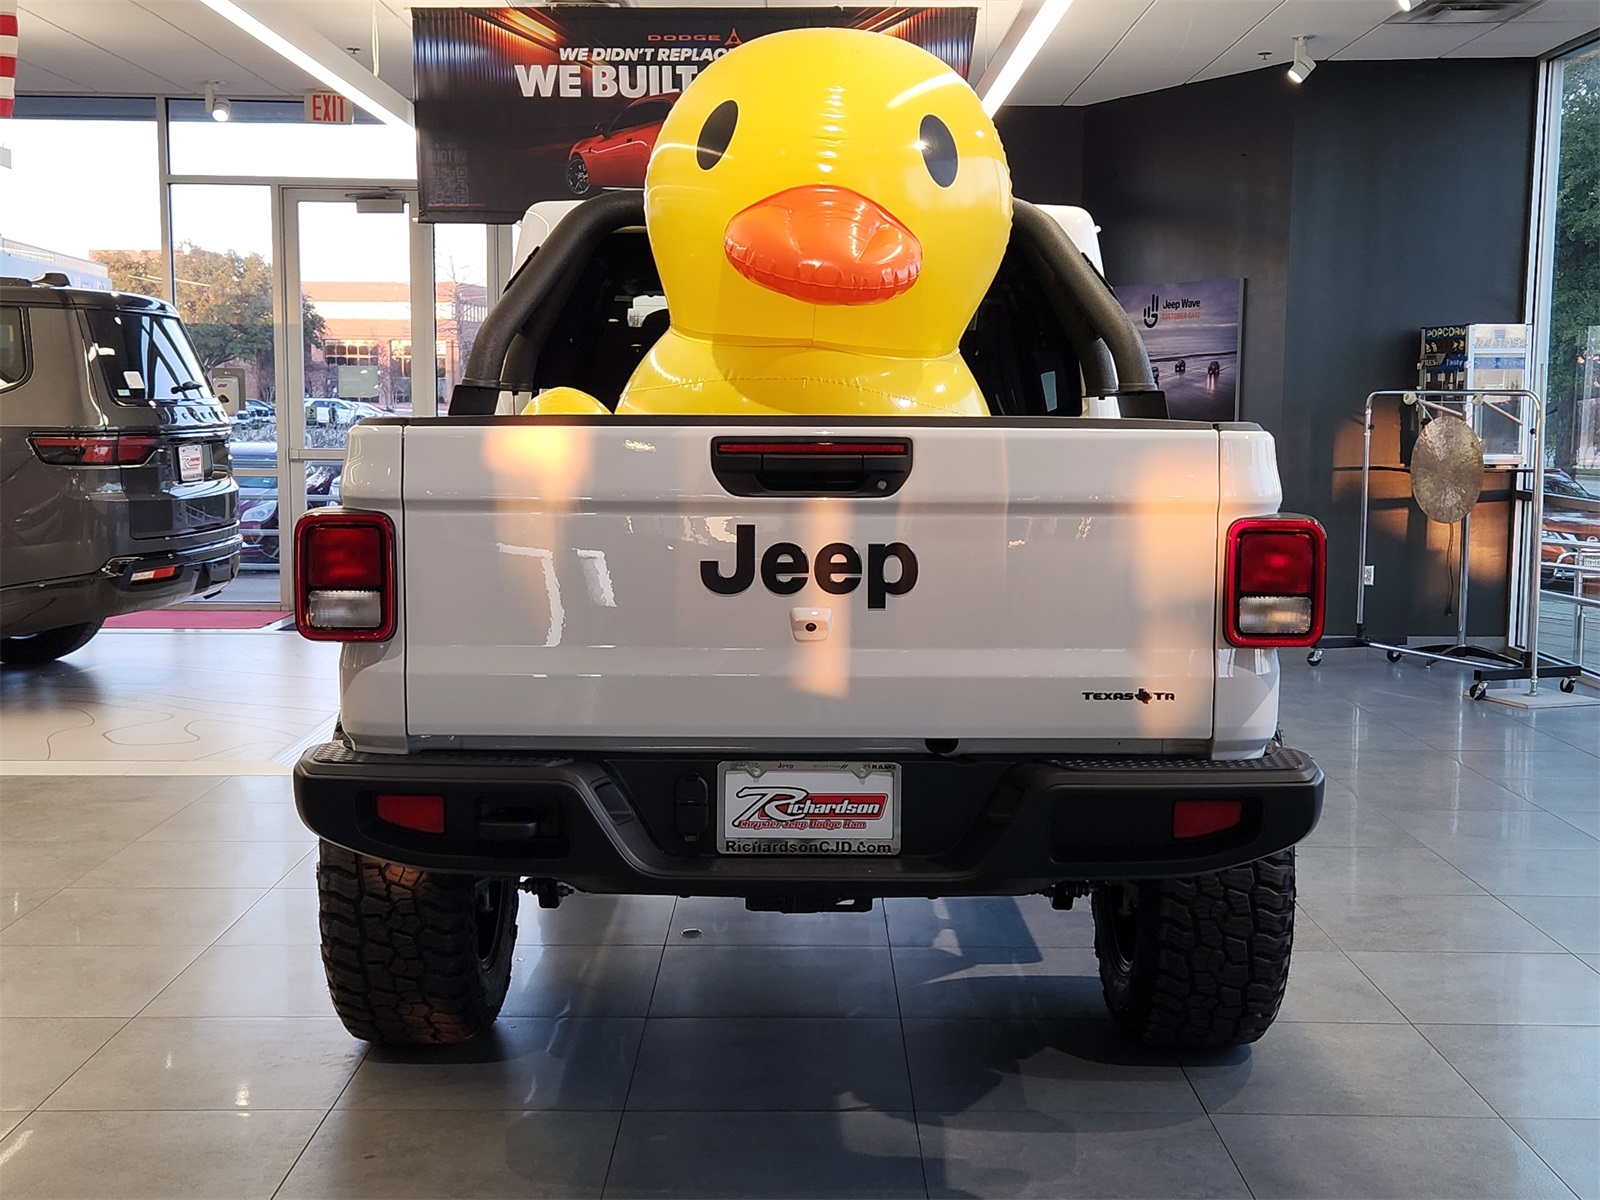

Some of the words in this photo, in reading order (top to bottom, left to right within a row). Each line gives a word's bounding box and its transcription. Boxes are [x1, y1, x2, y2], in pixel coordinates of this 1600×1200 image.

[647, 34, 721, 42] DODGE
[559, 47, 589, 62] WE
[590, 47, 654, 62] DIDN'T
[657, 47, 735, 62] REPLAC
[514, 65, 582, 98] WE
[592, 65, 699, 98] BUILT
[312, 94, 346, 122] EXIT
[1162, 299, 1180, 310] Jeep
[1181, 298, 1201, 309] Wave
[700, 524, 919, 609] Jeep
[1081, 692, 1134, 701] TEXAS
[1153, 692, 1175, 701] TR
[776, 762, 794, 770] Jeep
[732, 786, 880, 827] Richardson
[738, 820, 781, 830] Chrysler
[782, 820, 808, 830] Jeep
[809, 820, 842, 830] Dodge
[843, 820, 867, 829] Ram
[725, 840, 892, 854] RichardsonCJD.com
